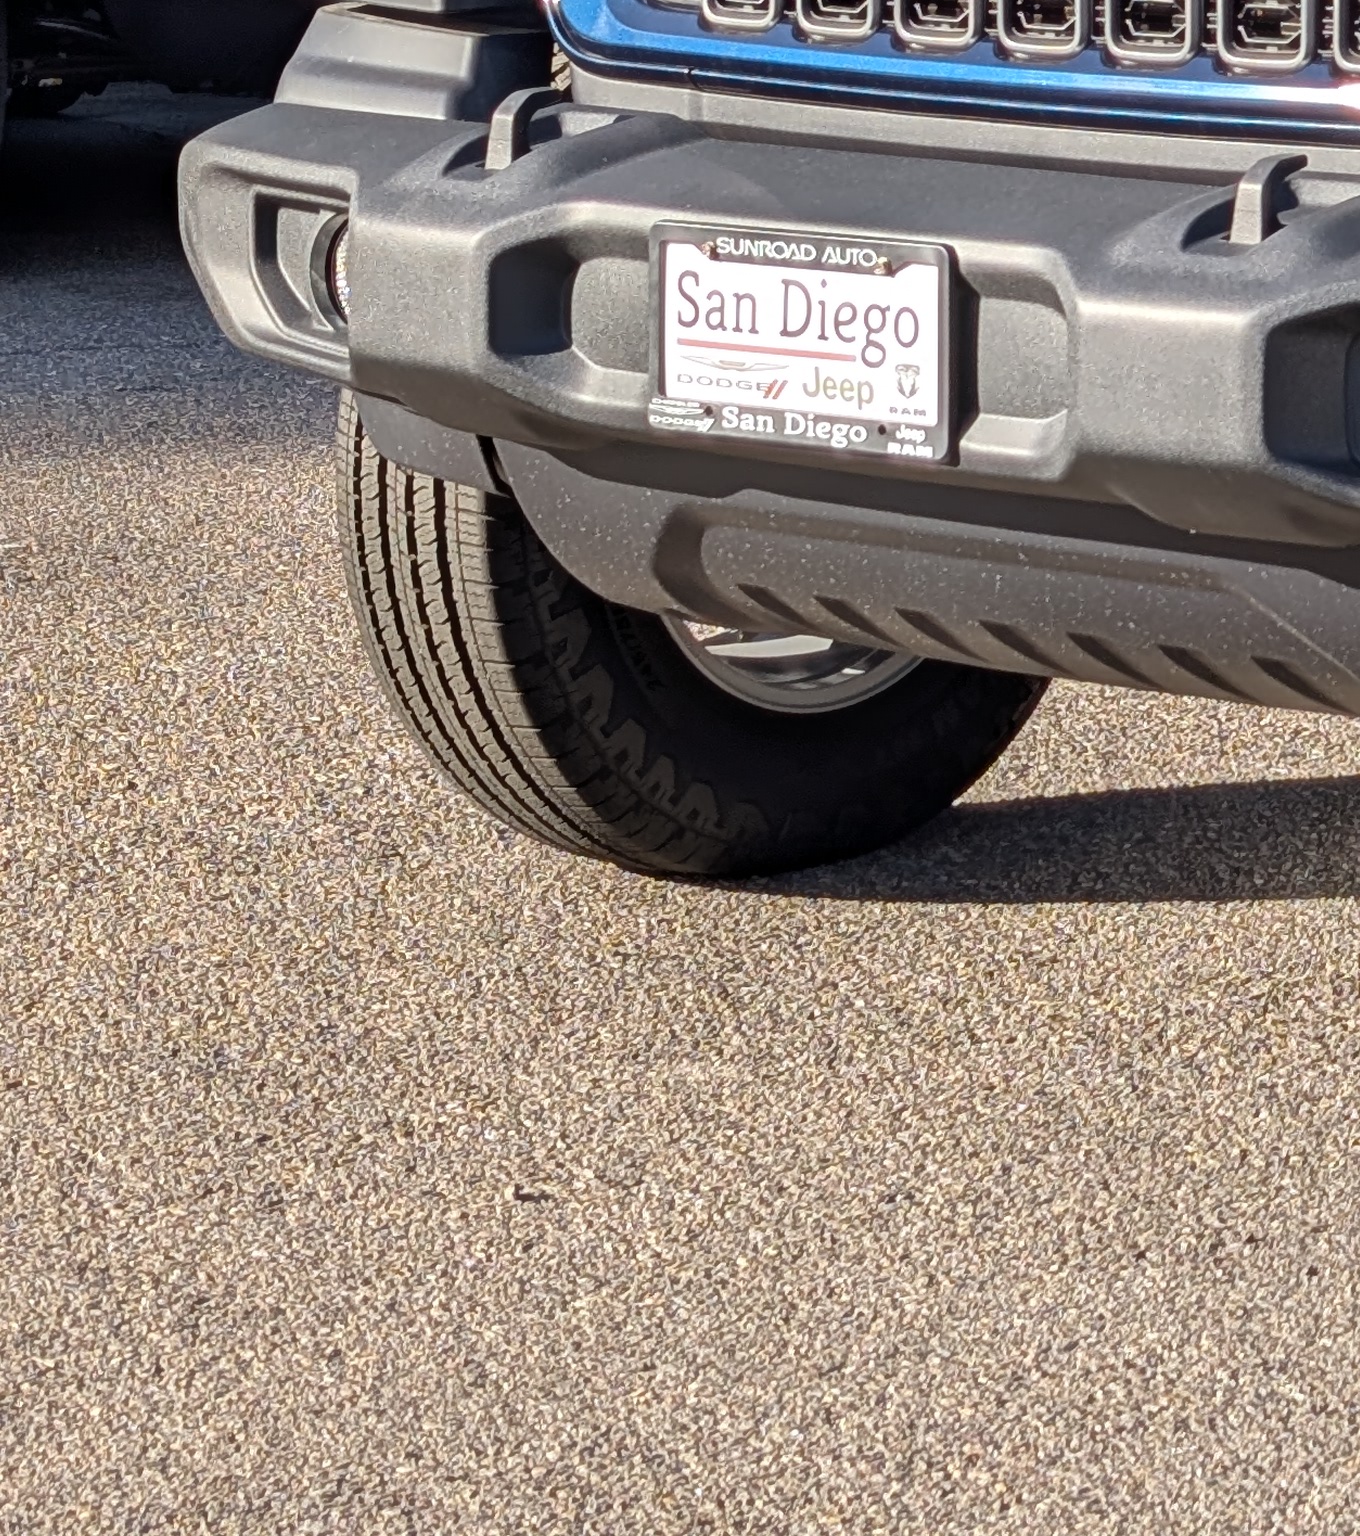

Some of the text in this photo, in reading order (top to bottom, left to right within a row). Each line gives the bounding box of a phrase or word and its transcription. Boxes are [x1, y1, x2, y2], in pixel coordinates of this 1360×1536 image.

[715, 236, 878, 267] SUNROAD AUTO
[677, 269, 920, 368] San Diego
[676, 372, 773, 393] DODGE
[802, 366, 875, 410] Jeep
[889, 406, 927, 417] RAM
[721, 406, 869, 448] San Diego
[895, 424, 926, 444] Jeep
[887, 442, 934, 458] RAM
